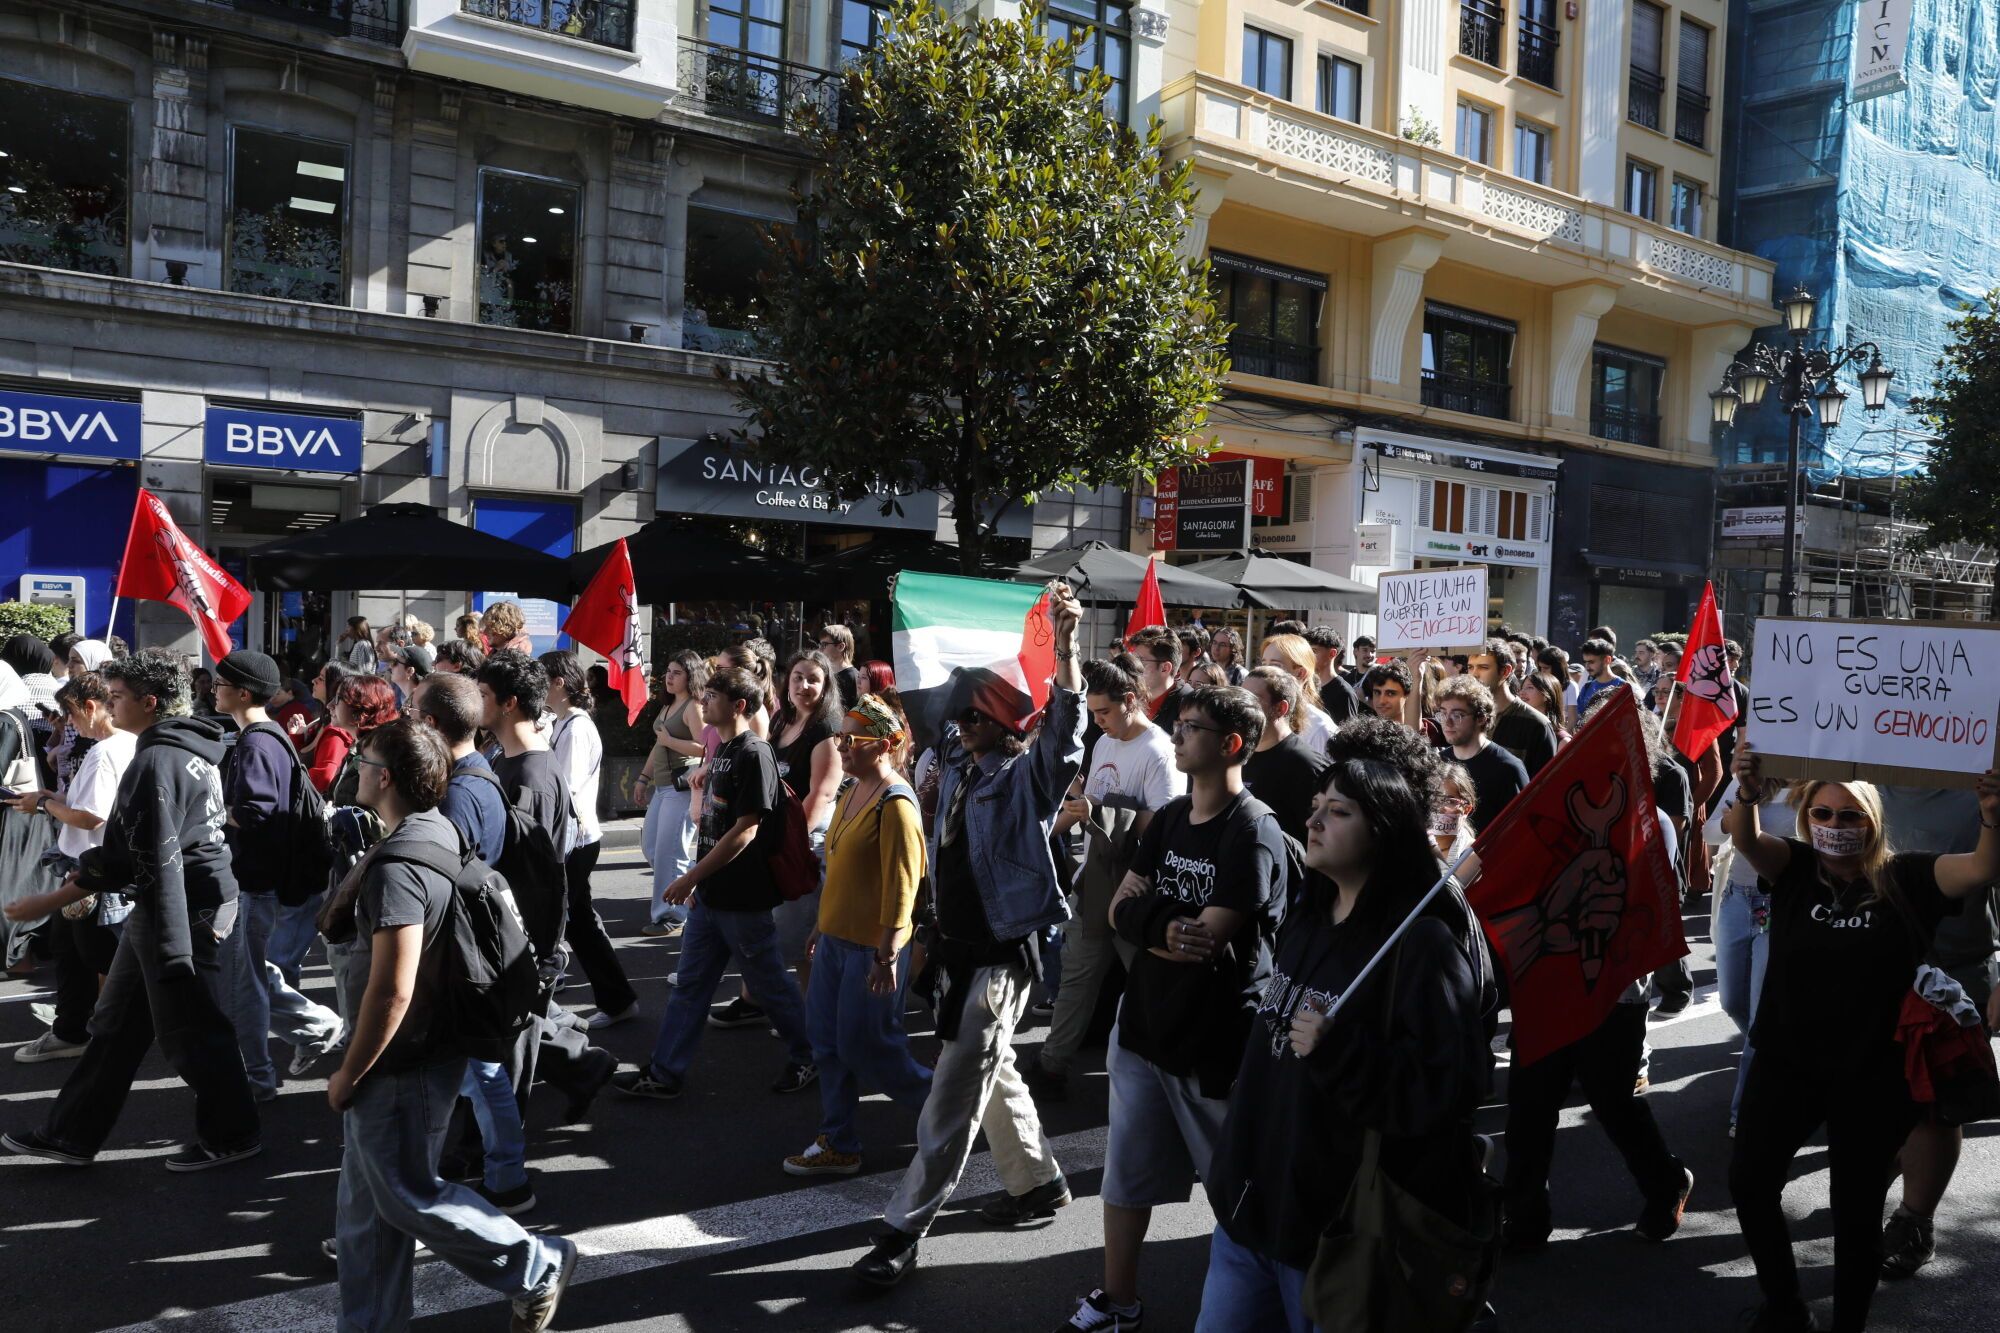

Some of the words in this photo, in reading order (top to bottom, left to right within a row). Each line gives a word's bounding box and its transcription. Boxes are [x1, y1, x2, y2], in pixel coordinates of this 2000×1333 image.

[227, 423, 341, 457] BBVA
[1183, 470, 1243, 488] VETUSTA
[1252, 478, 1274, 491] AFÉ
[756, 491, 796, 507] Coffee
[799, 494, 809, 508] &
[813, 496, 850, 515] Bary
[1183, 520, 1235, 531] SANTAGLORIA
[1261, 535, 1296, 544] neosens
[1504, 548, 1535, 559] neosens
[1383, 601, 1429, 622] GUERRA
[1436, 602, 1446, 616] E
[1451, 597, 1471, 612] UN
[1395, 615, 1482, 640] XENOCIDIO
[1772, 632, 1813, 665] NO
[1836, 636, 1878, 672] ES
[1900, 639, 1973, 677] UNA
[1844, 673, 1952, 702] GUERRA
[1752, 697, 1798, 724] ES
[1814, 701, 1858, 731] UN
[1639, 815, 1654, 843] de
[1165, 850, 1216, 877] Depresión
[1810, 904, 1871, 928] Cao!
